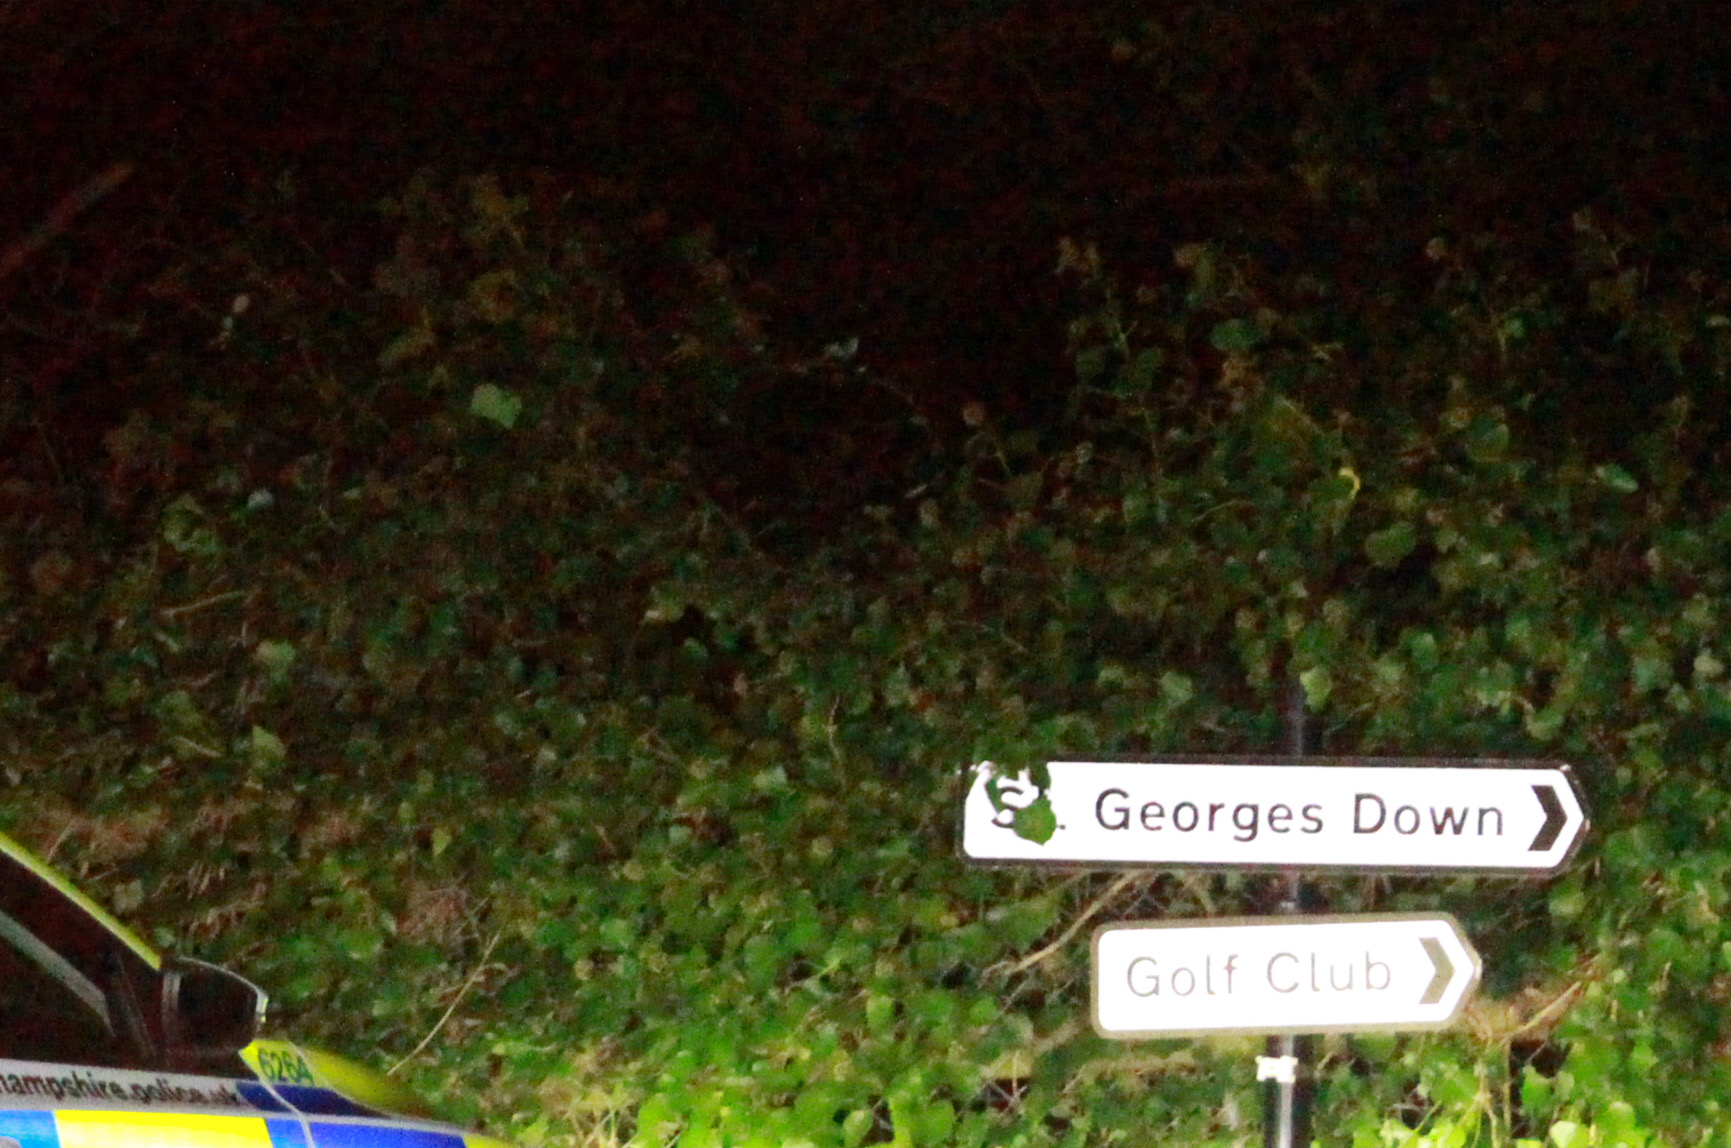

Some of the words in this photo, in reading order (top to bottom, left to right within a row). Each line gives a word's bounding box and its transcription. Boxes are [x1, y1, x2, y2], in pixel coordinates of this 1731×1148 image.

[1094, 788, 1323, 842] Georges
[1352, 793, 1503, 835] Down
[1126, 953, 1240, 998] Golf
[1266, 951, 1391, 994] Club
